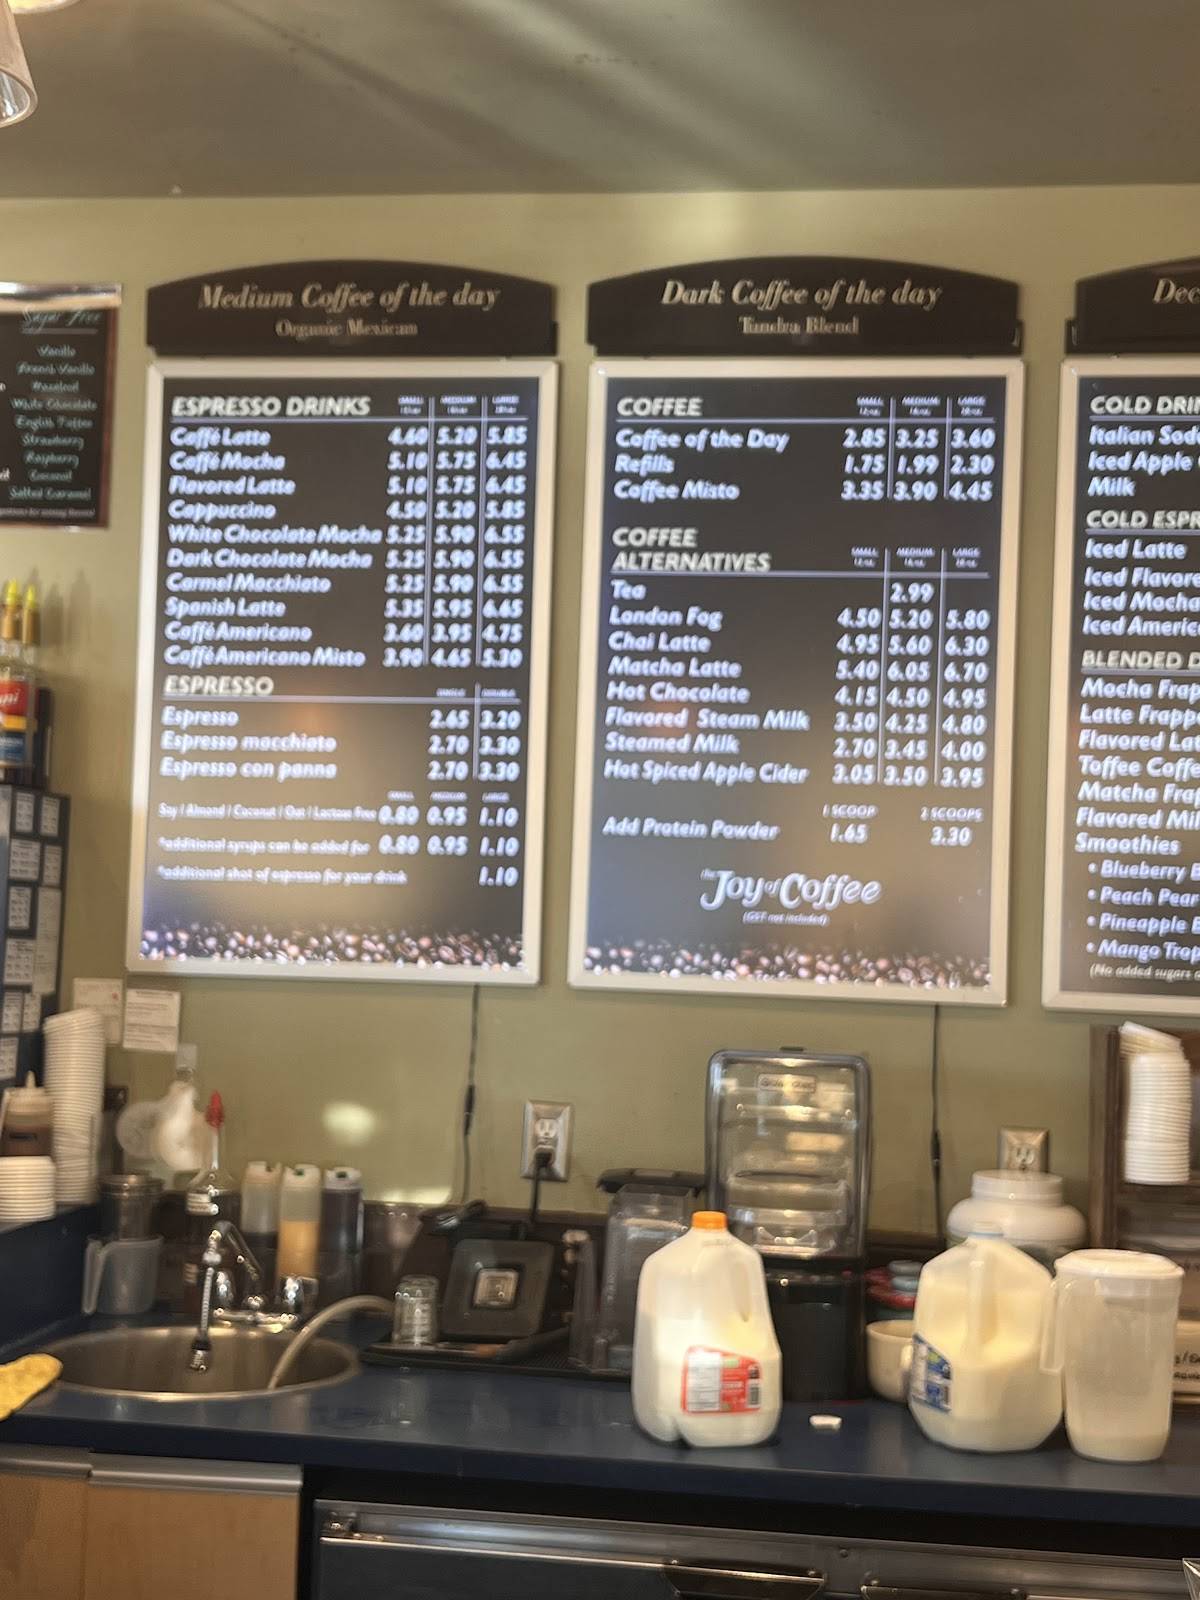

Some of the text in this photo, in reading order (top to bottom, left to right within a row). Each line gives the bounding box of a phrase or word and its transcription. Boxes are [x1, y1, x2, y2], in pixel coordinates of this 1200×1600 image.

[200, 283, 501, 313] Medium Coffee of the day
[662, 279, 942, 310] Dark Coffee of the day
[347, 320, 418, 336] Mexican
[739, 317, 859, 336] Tundra Blend
[171, 397, 370, 417] ESPRESSO DRINKS
[617, 398, 703, 416] COFFEE
[1091, 396, 1151, 415] COLD
[223, 429, 272, 446] Latte
[615, 429, 995, 453] Coffee of the Day 2.85 3.25 3.60
[1089, 425, 1154, 445] Italian
[223, 454, 285, 471] Mocha
[615, 454, 994, 477] Refills 1.75 1.99 2.30
[1088, 452, 1193, 475] Iced Apple
[169, 477, 296, 496] Flavored Latte
[613, 480, 992, 502] Coffee Misto 3.35 3.90 4.45
[1088, 477, 1135, 497] Milk
[168, 501, 276, 524] Cappuccino
[1087, 510, 1148, 529] COLD
[168, 525, 383, 545] White Chocolate Mocha
[612, 528, 697, 547] COFFEE
[167, 549, 373, 569] Dark Chocolate Mocha
[1085, 539, 1187, 559] Iced Latte
[612, 552, 770, 572] ALTERNATIVES
[234, 574, 331, 594] Macchiato
[1084, 567, 1127, 587] Iced
[611, 579, 934, 603] Tea 2.99
[1083, 591, 1126, 611] Iced
[165, 597, 286, 620] Spanish Latte
[609, 606, 990, 631] London Fog 4.50 5.20 5.80
[215, 623, 312, 642] Americano
[1083, 616, 1125, 635] Iced
[609, 631, 989, 657] Chai Latte 4.95 5.60 6.30
[215, 648, 366, 667] Americano Misto
[1082, 651, 1181, 669] BLENDED
[609, 657, 989, 682] Matcha Latte 5.40 6.05 6.70
[164, 676, 273, 695] ESPRESSO
[607, 682, 986, 709] Hot Chocolate 4.15 4.50 4.95
[1081, 678, 1152, 699] Mocha
[162, 706, 521, 730] Espresso 2.65 3.20
[605, 707, 810, 731] Flavored Steam Milk
[1080, 704, 1133, 724] Latte
[161, 731, 520, 756] Espresso macchiato 2.70 3.30
[605, 732, 739, 754] Steamed Milk
[1079, 729, 1163, 750] Flavored
[160, 757, 519, 783] Espresso con panna 2.70 3.30
[604, 759, 809, 787] Hot Spiced Apple Cider
[1079, 754, 1141, 780] Toffee
[1078, 781, 1158, 802] Matcha
[379, 805, 518, 827] 0.80 0.95 1.10
[833, 805, 878, 818] SCOOP
[929, 807, 983, 821] SCOOPS
[1076, 807, 1160, 829] Flavored
[603, 817, 971, 847] Add Protein Powder 1.65 3.30
[379, 834, 518, 856] 0.80 0.95 1.10
[1075, 832, 1180, 854] Smoothies
[479, 867, 518, 887] 1.10
[1101, 859, 1185, 882] Blueberry
[700, 870, 764, 910] Joy
[780, 872, 881, 910] Coffee
[1100, 885, 1152, 903] Peach
[1099, 912, 1187, 936] Pineapple
[1098, 939, 1159, 963] Mango
